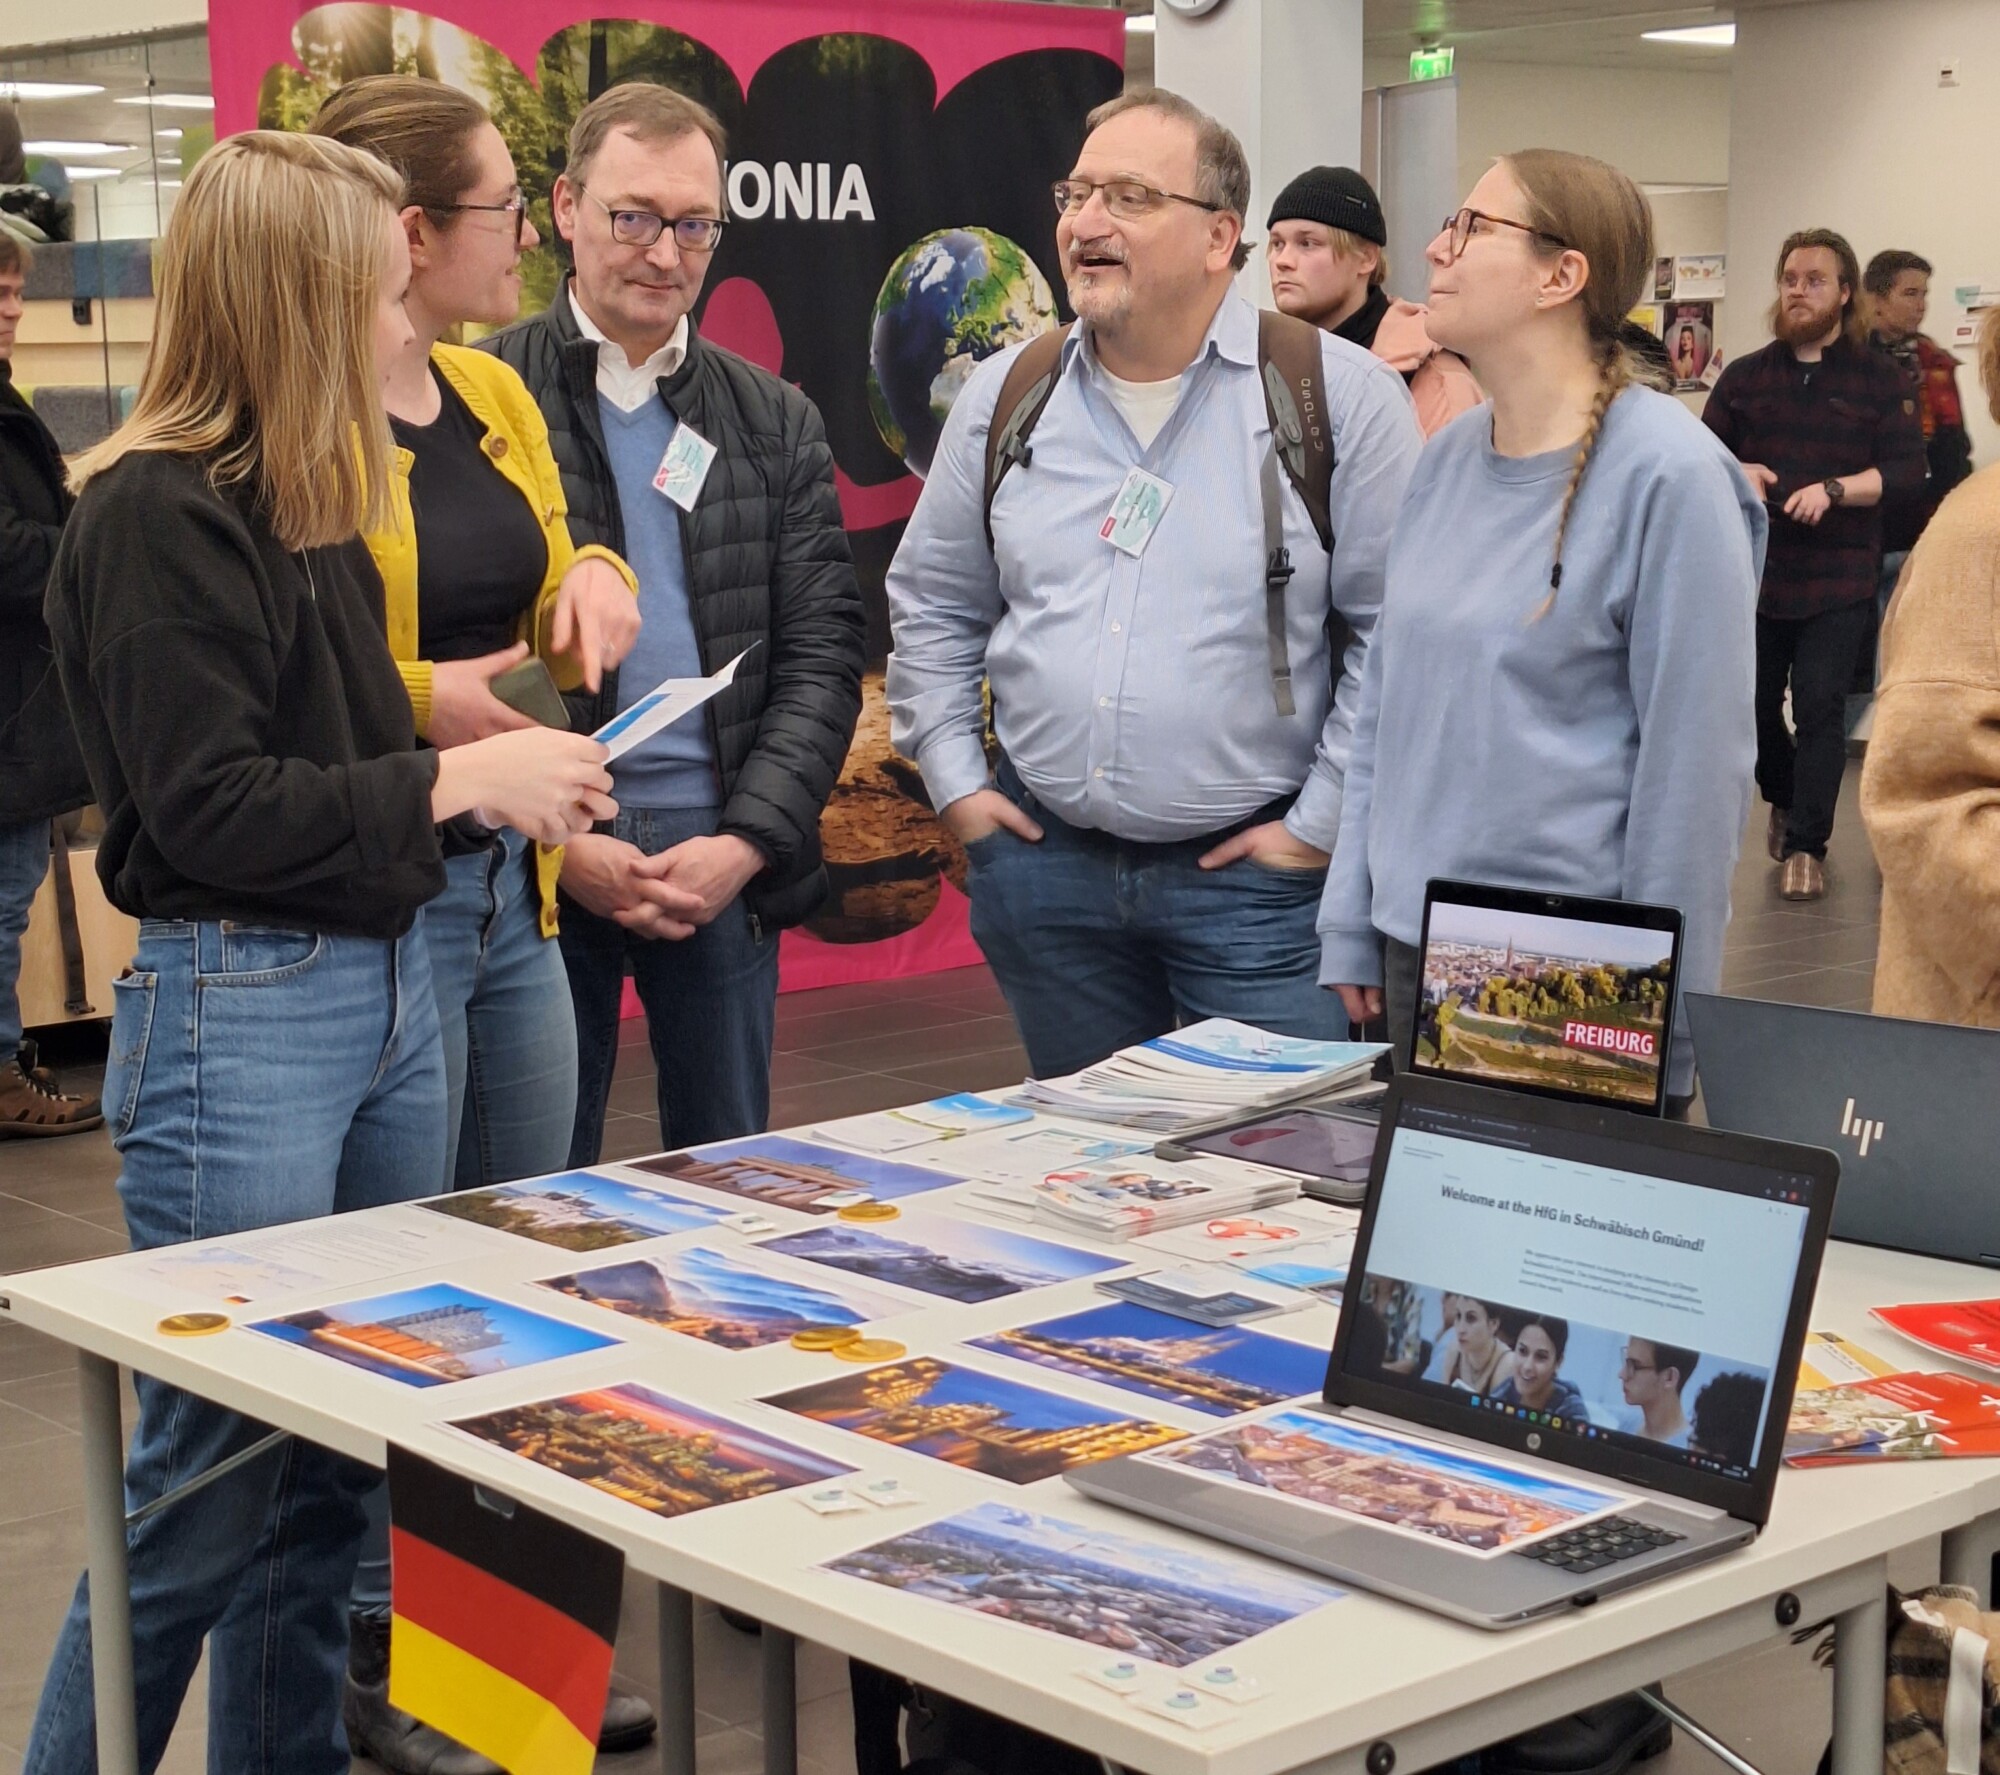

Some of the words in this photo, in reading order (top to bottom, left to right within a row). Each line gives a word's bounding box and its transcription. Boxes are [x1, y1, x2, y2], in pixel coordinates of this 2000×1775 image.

[724, 160, 876, 221] ONIA
[1565, 1021, 1654, 1055] FREIBURG
[1441, 1184, 1495, 1208] Welcome
[1497, 1200, 1510, 1211] at
[1512, 1200, 1532, 1216] the
[1534, 1204, 1557, 1222] HfG
[1560, 1209, 1572, 1224] in
[1573, 1213, 1650, 1241] Schwäbisch
[1652, 1230, 1705, 1252] Gmünd!
